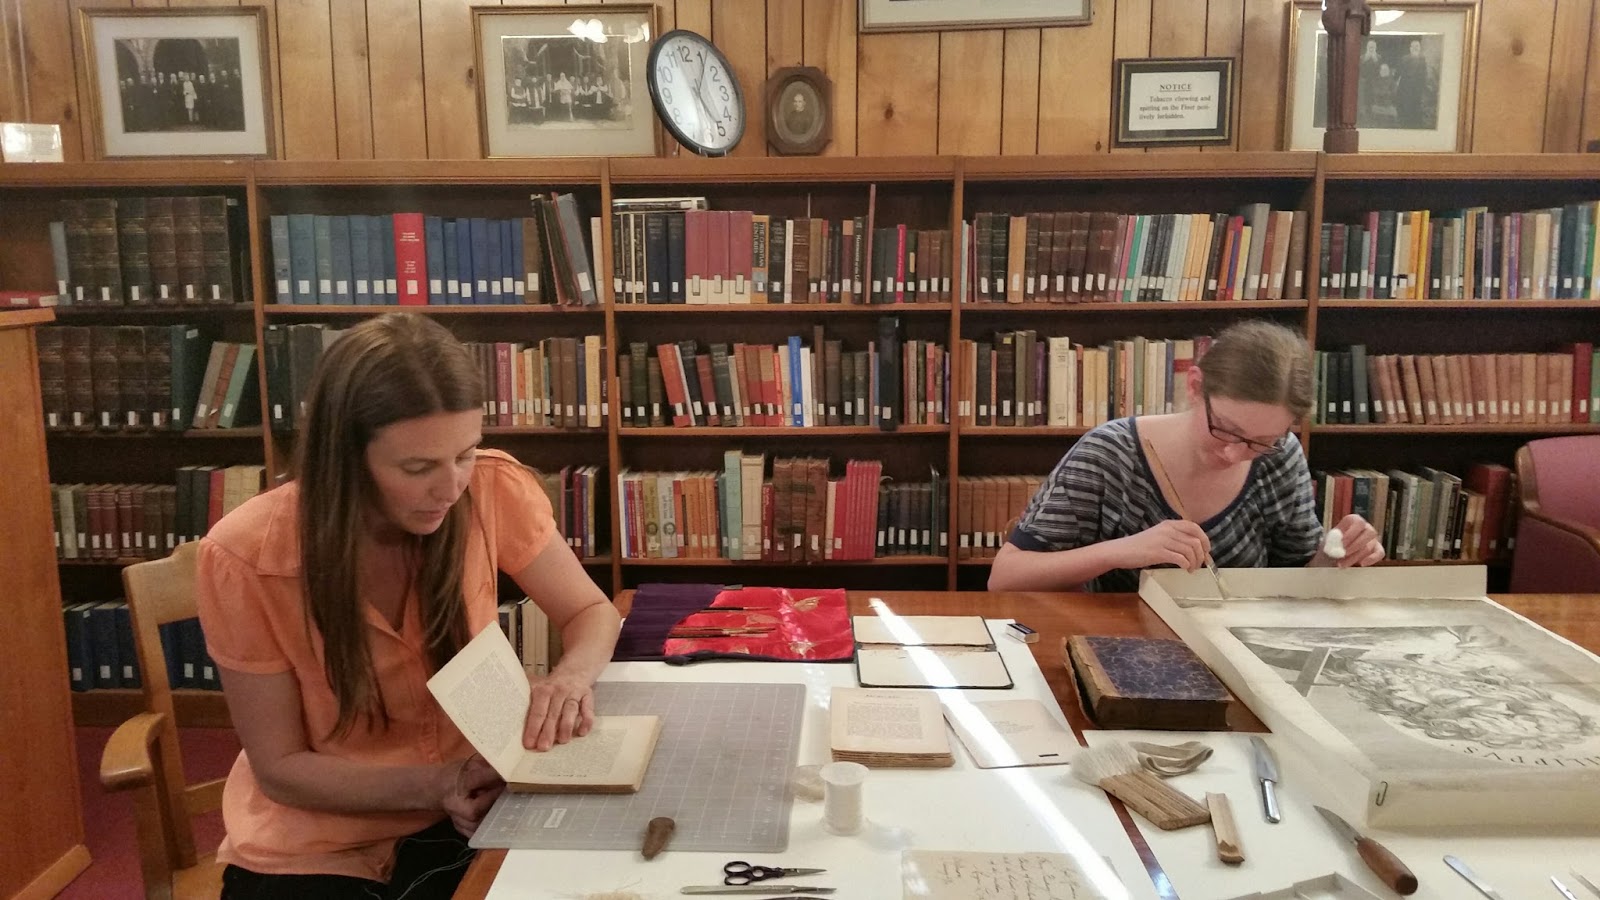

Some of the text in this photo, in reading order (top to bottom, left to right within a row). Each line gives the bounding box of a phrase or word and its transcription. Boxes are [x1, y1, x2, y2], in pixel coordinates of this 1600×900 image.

[677, 45, 693, 63] 12
[658, 66, 673, 84] 10
[710, 65, 720, 82] 2
[662, 87, 673, 105] 9
[719, 85, 730, 102] 3
[673, 107, 681, 125] 8
[723, 105, 732, 122] 4
[715, 120, 726, 137] 5
